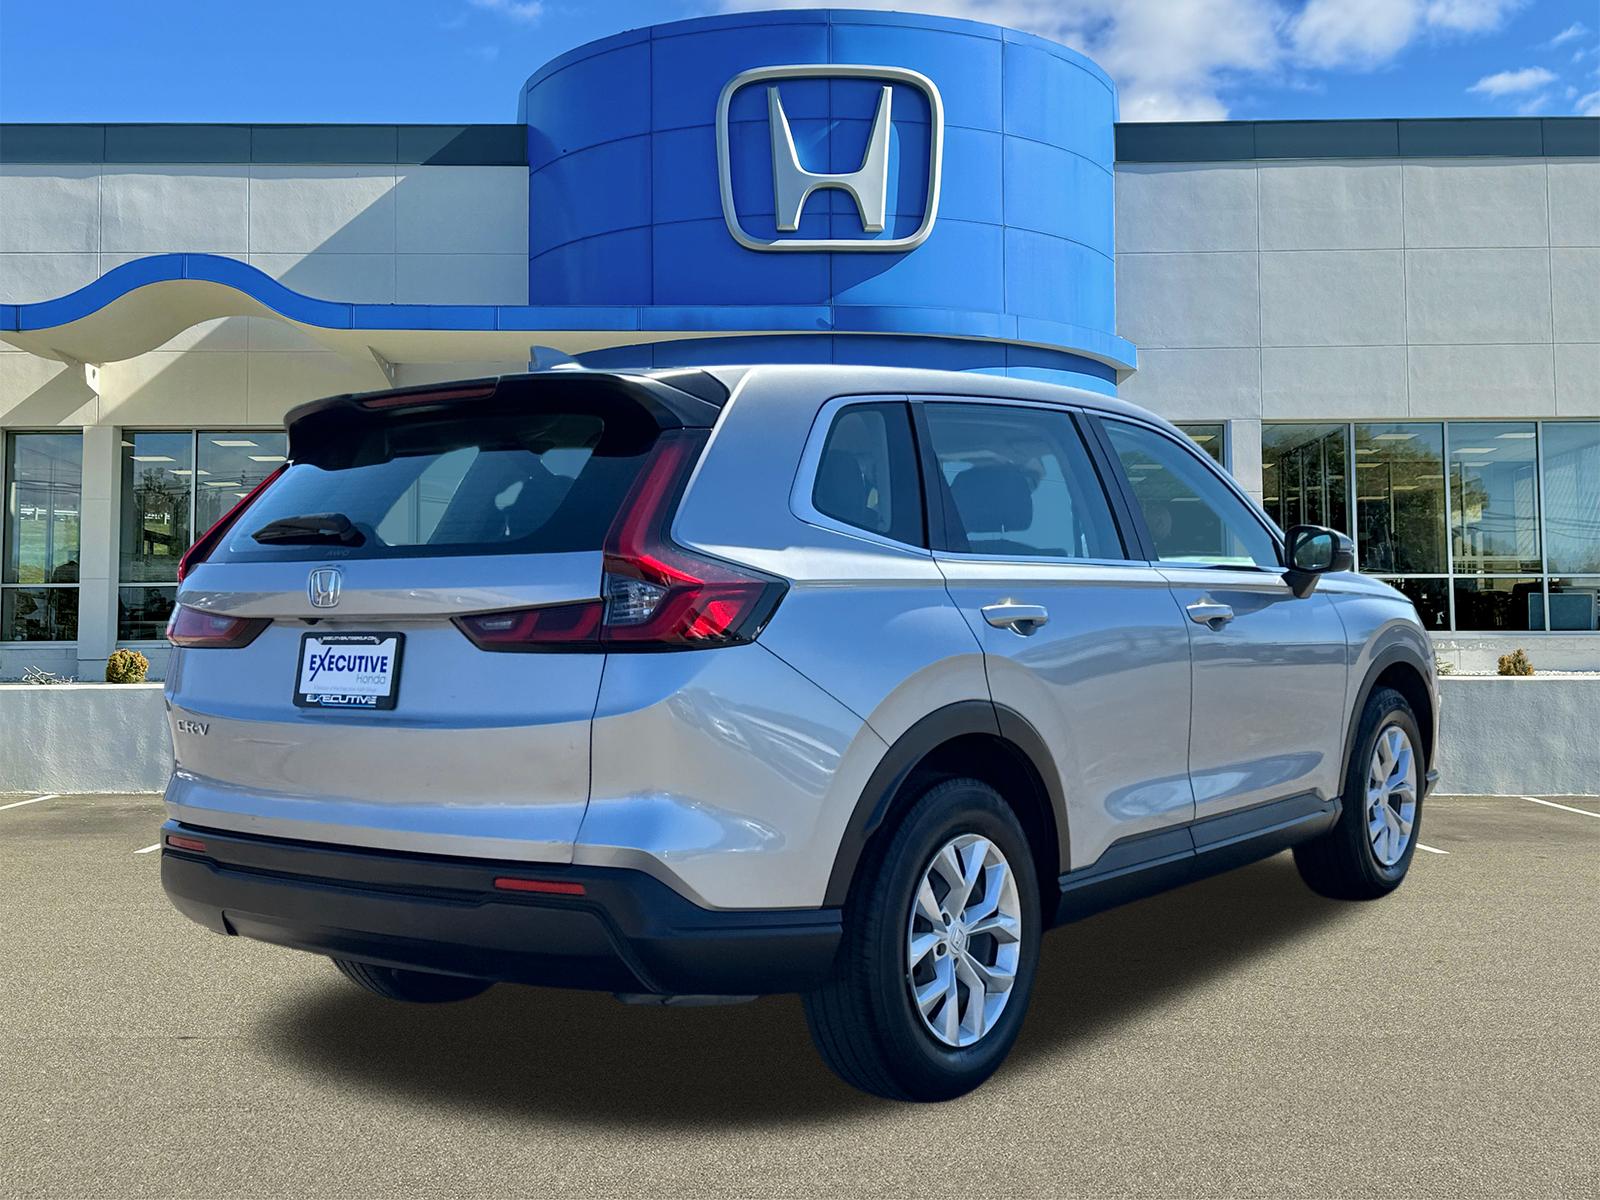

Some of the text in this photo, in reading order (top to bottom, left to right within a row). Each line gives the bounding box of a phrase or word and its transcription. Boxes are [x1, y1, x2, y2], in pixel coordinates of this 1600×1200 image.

[309, 647, 388, 682] EXECUTIVE
[356, 674, 386, 685] Honda
[306, 694, 377, 704] EXECUTIVE
